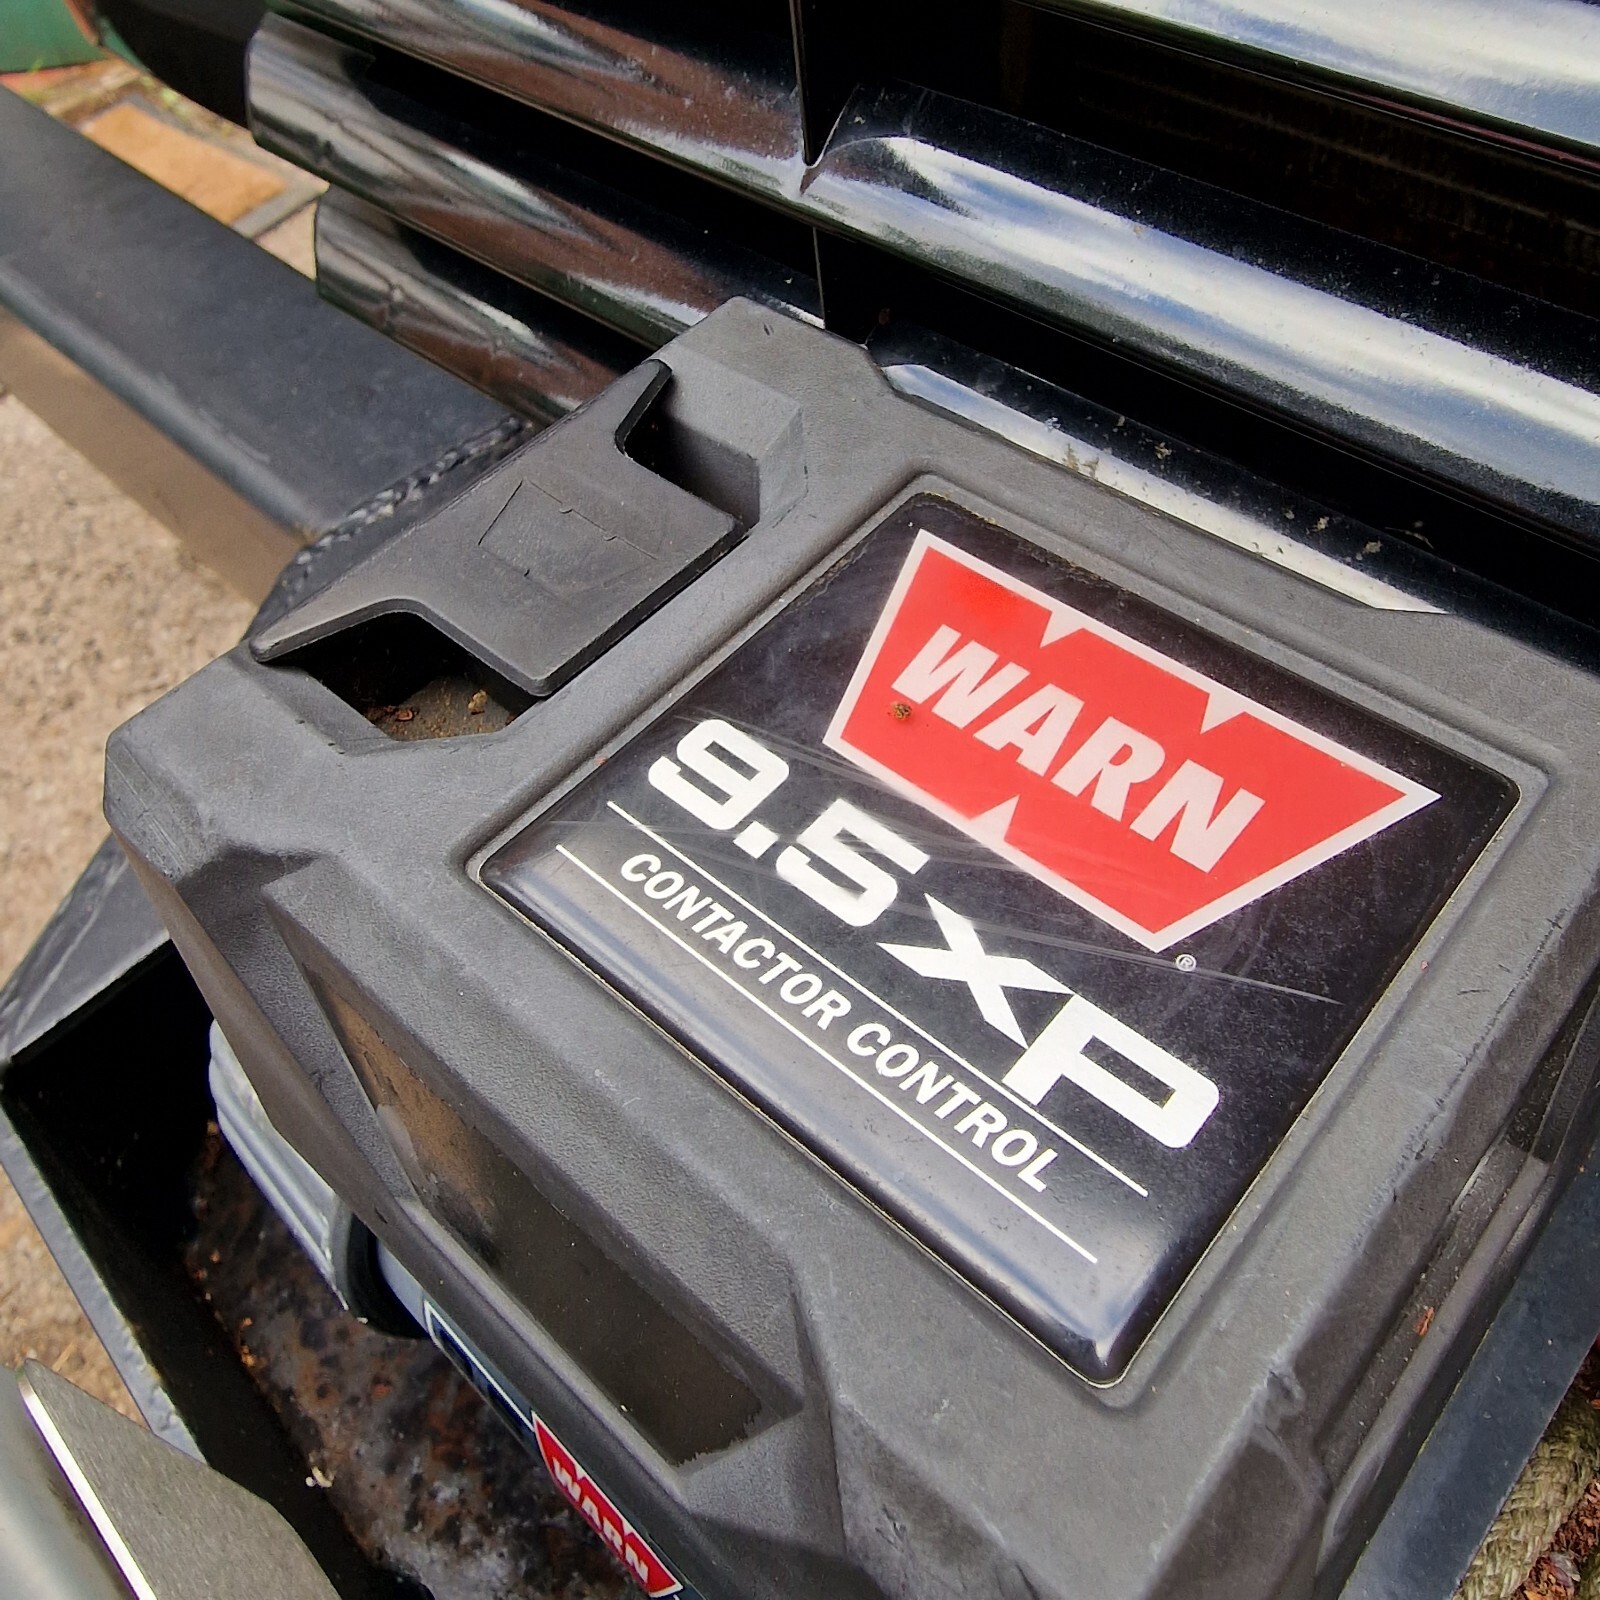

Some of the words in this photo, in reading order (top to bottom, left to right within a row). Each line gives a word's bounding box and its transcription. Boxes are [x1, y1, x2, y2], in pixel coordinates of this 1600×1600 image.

[890, 623, 1266, 874] WARN
[620, 852, 852, 1031] CONTACTOR
[846, 1021, 1061, 1192] CONTROL
[551, 1456, 650, 1584] WARN
